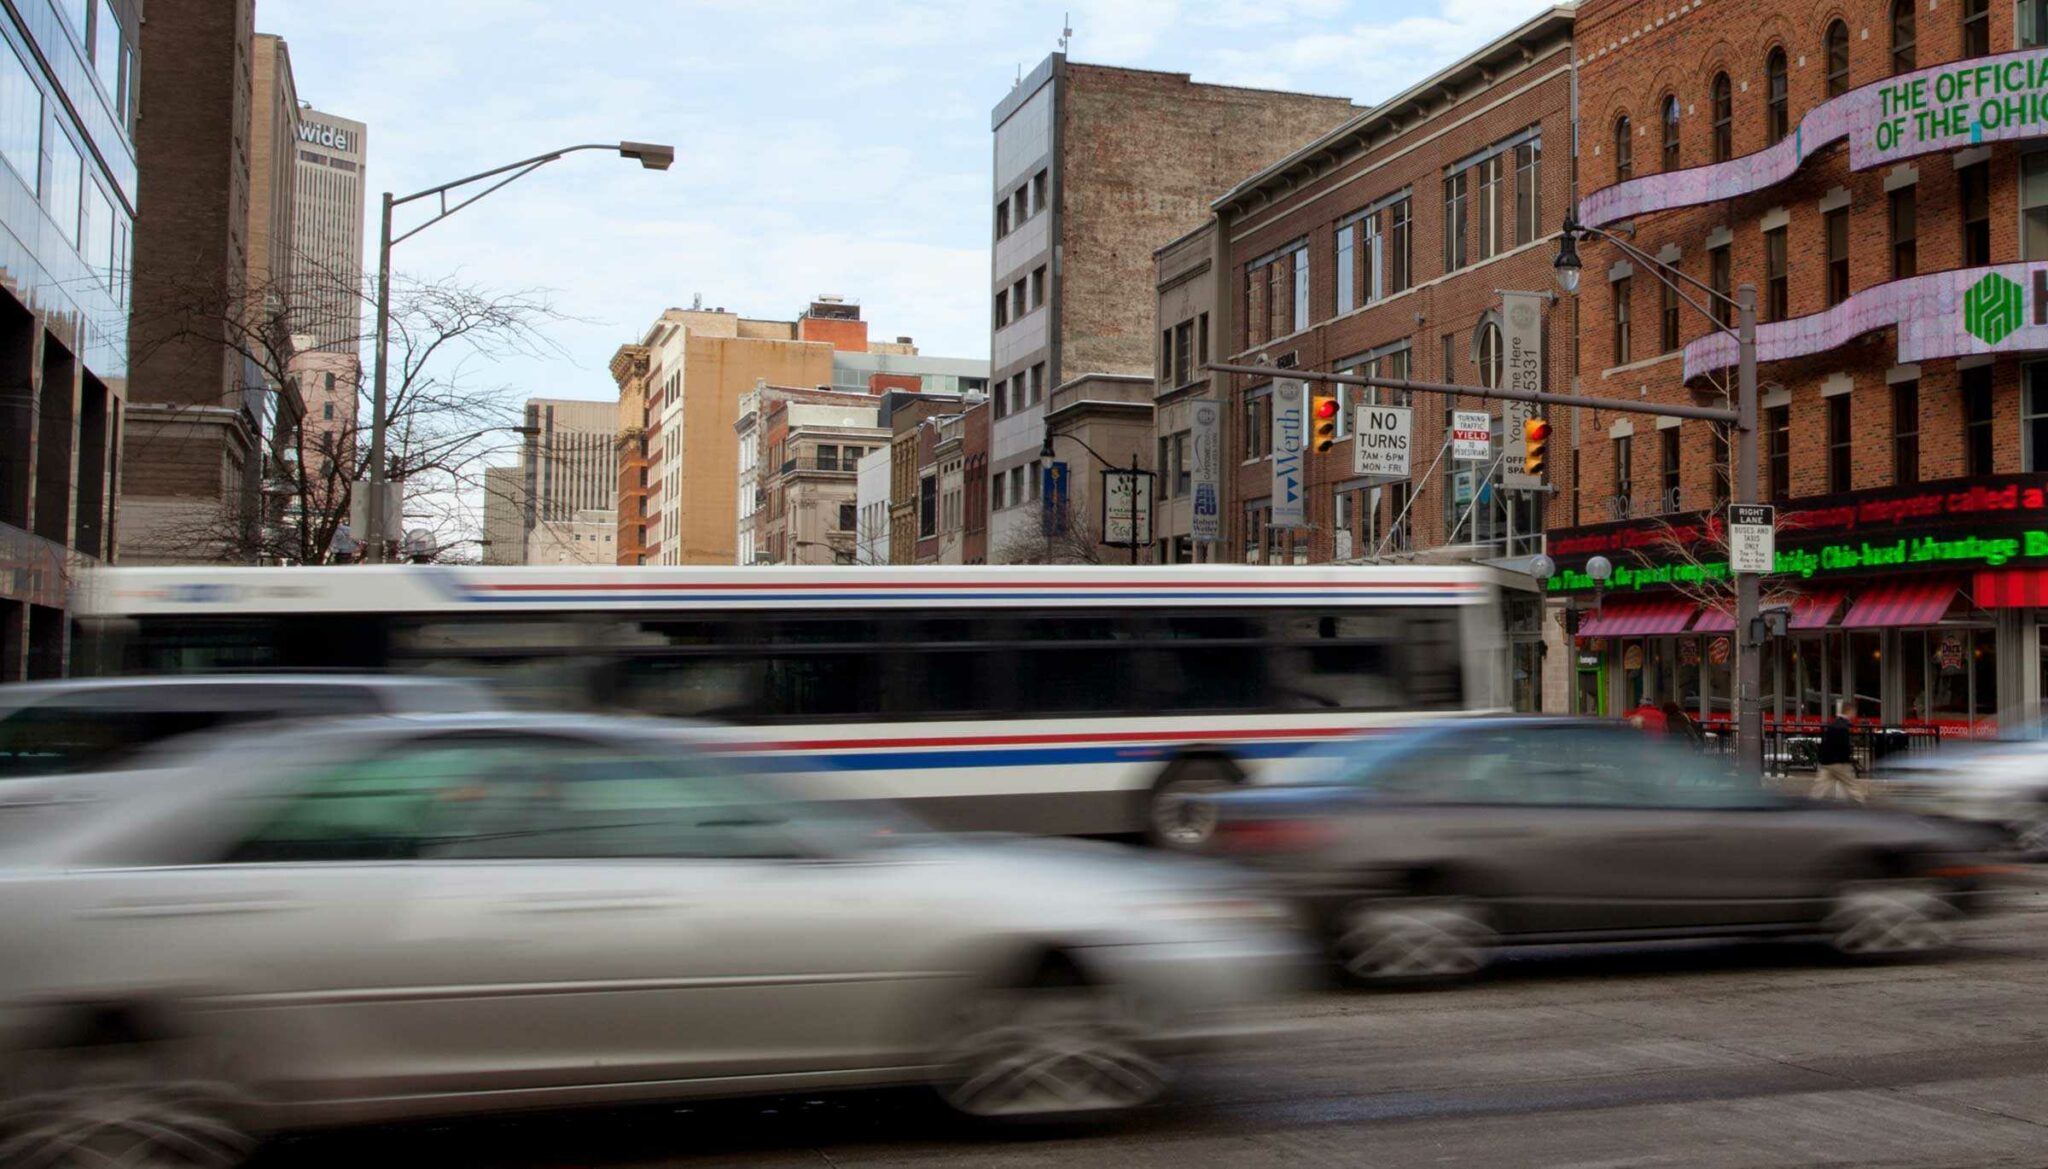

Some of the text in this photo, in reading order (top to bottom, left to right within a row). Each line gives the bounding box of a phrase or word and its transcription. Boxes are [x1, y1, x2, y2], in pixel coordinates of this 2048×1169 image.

[1879, 79, 1927, 117] THE
[299, 124, 347, 149] wide
[1876, 117, 1906, 151] OF
[1914, 104, 1970, 142] THE
[1510, 336, 1521, 444] Your Nme Here
[1370, 412, 1397, 431] NO
[1460, 422, 1485, 430] TRAFFIC
[1276, 409, 1300, 477] Werth
[1359, 432, 1407, 449] TURNS
[1456, 430, 1488, 440] YIELD
[1739, 507, 1764, 516] RIGHT
[1740, 516, 1763, 524] LANE
[1734, 526, 1769, 535] BUSES AND
